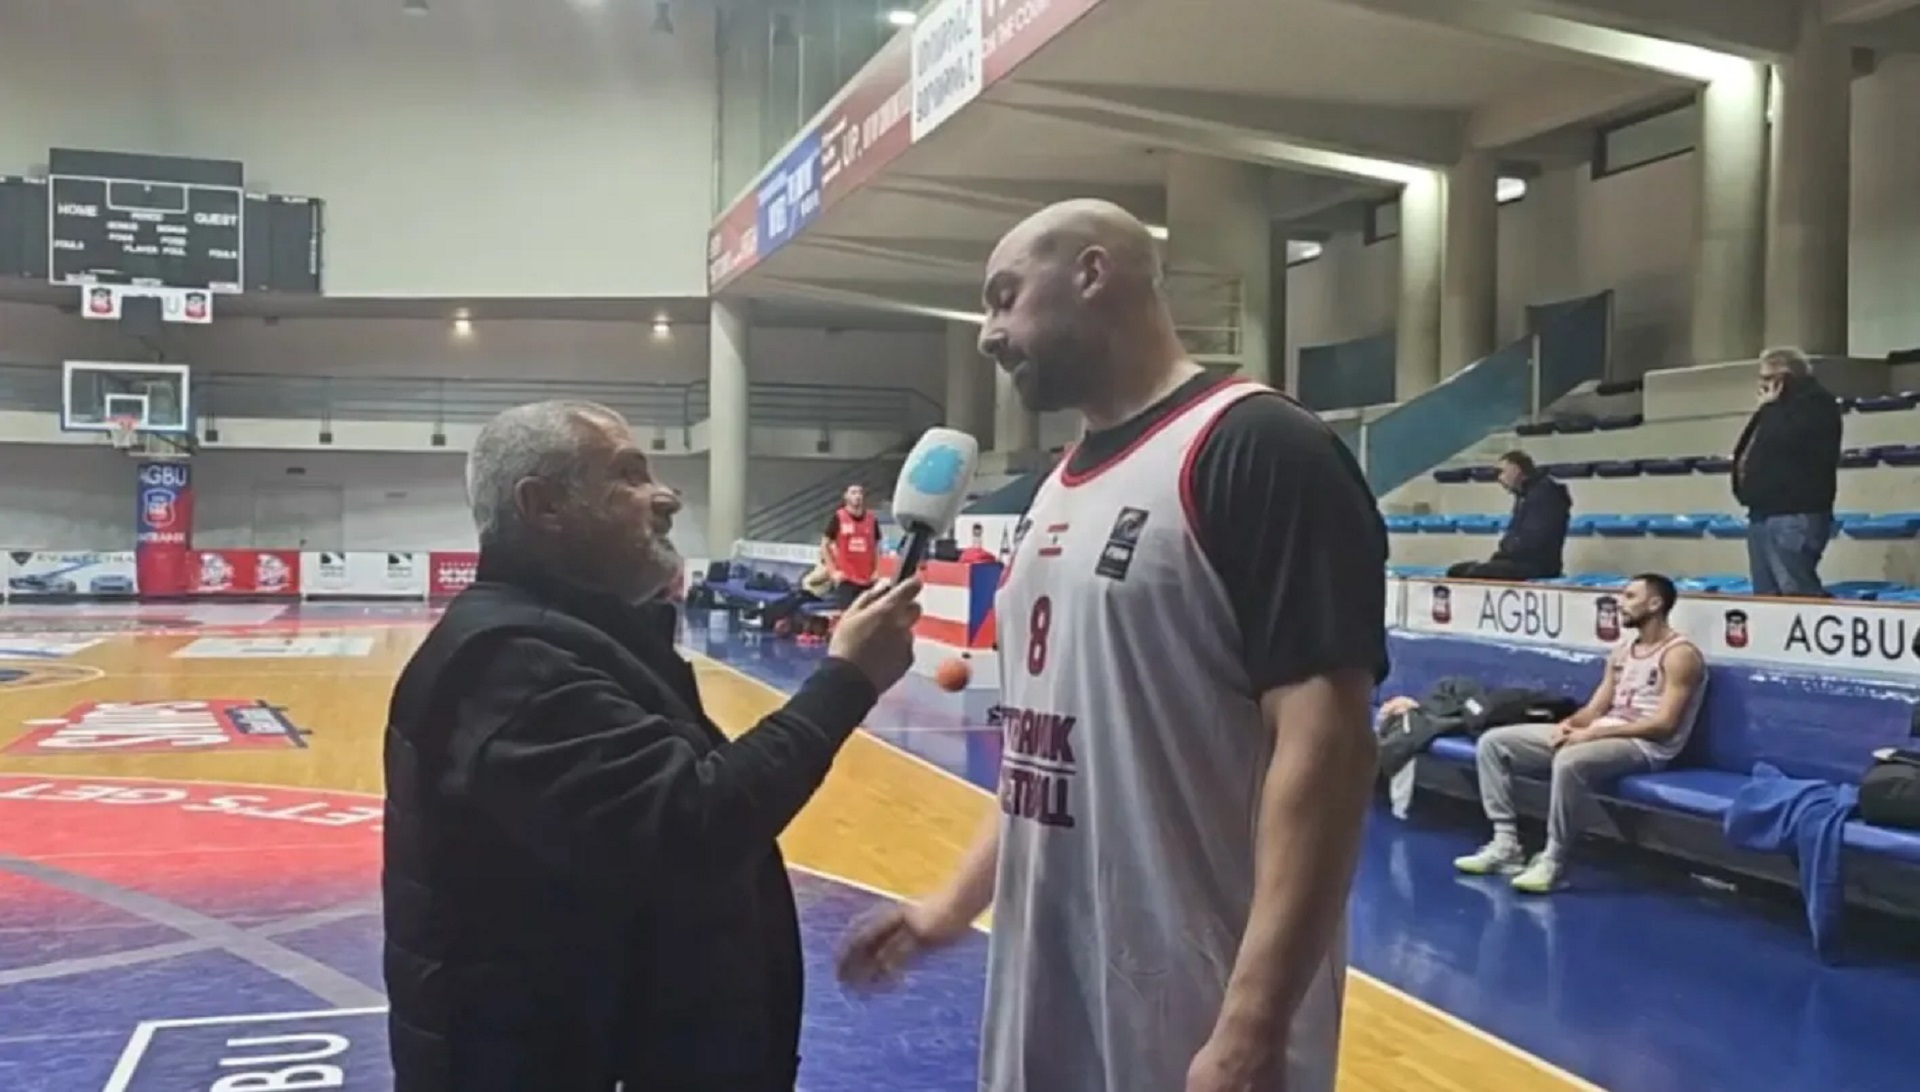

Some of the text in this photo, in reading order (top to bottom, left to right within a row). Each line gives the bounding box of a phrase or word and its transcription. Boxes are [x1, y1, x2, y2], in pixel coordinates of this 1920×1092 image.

[57, 202, 98, 217] HOME
[1028, 596, 1051, 676] 8
[1478, 588, 1564, 639] AGBU
[1784, 612, 1906, 660] AGBU
[181, 794, 384, 827] ET'S
